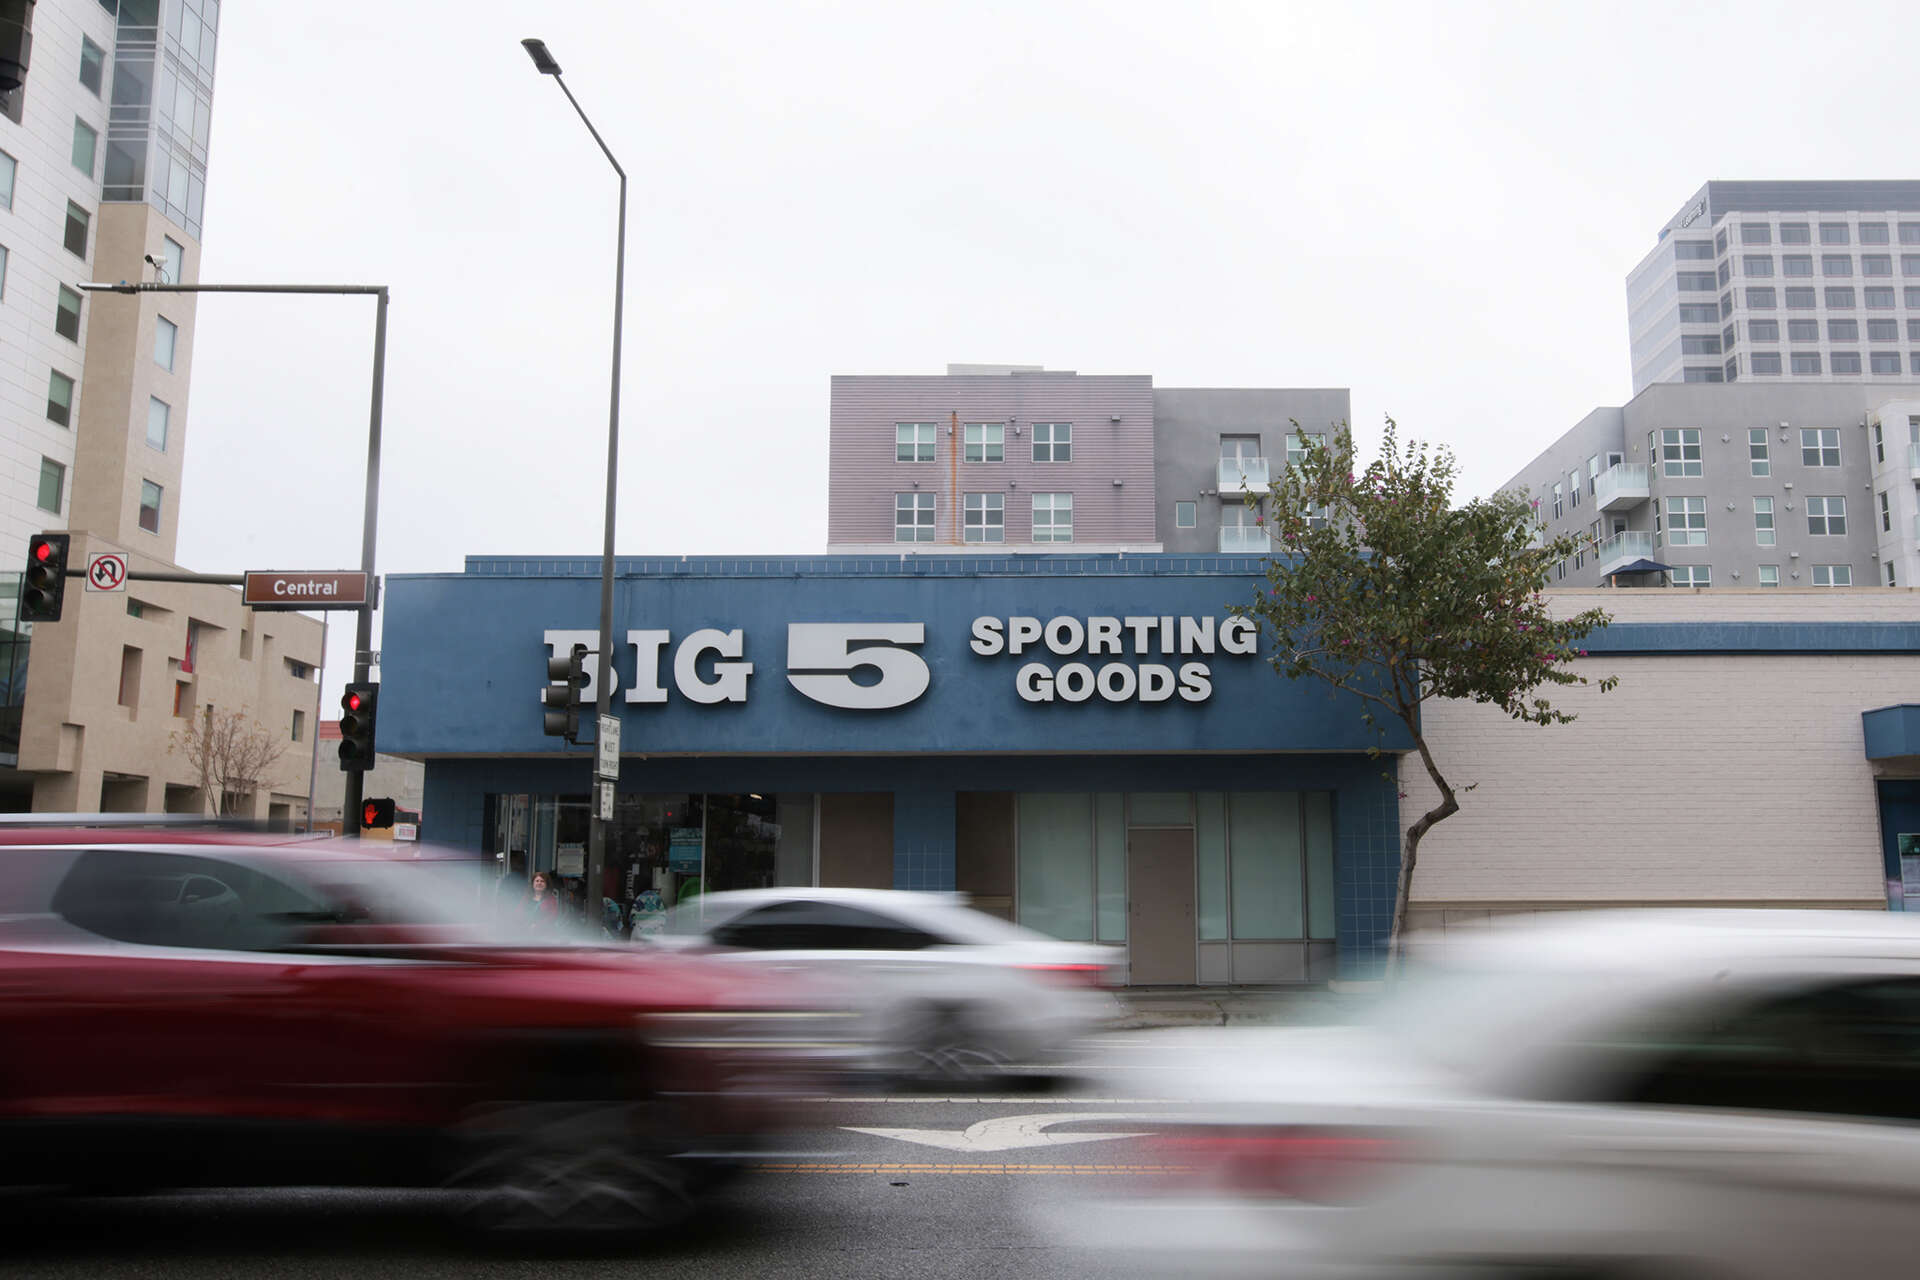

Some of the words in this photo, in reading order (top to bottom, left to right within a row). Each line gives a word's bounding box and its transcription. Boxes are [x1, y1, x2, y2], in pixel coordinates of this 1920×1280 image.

[273, 579, 338, 596] Central
[969, 615, 1257, 656] SPORTING
[541, 628, 754, 704] BIG
[786, 622, 931, 710] 5
[1015, 662, 1213, 702] GOODS
